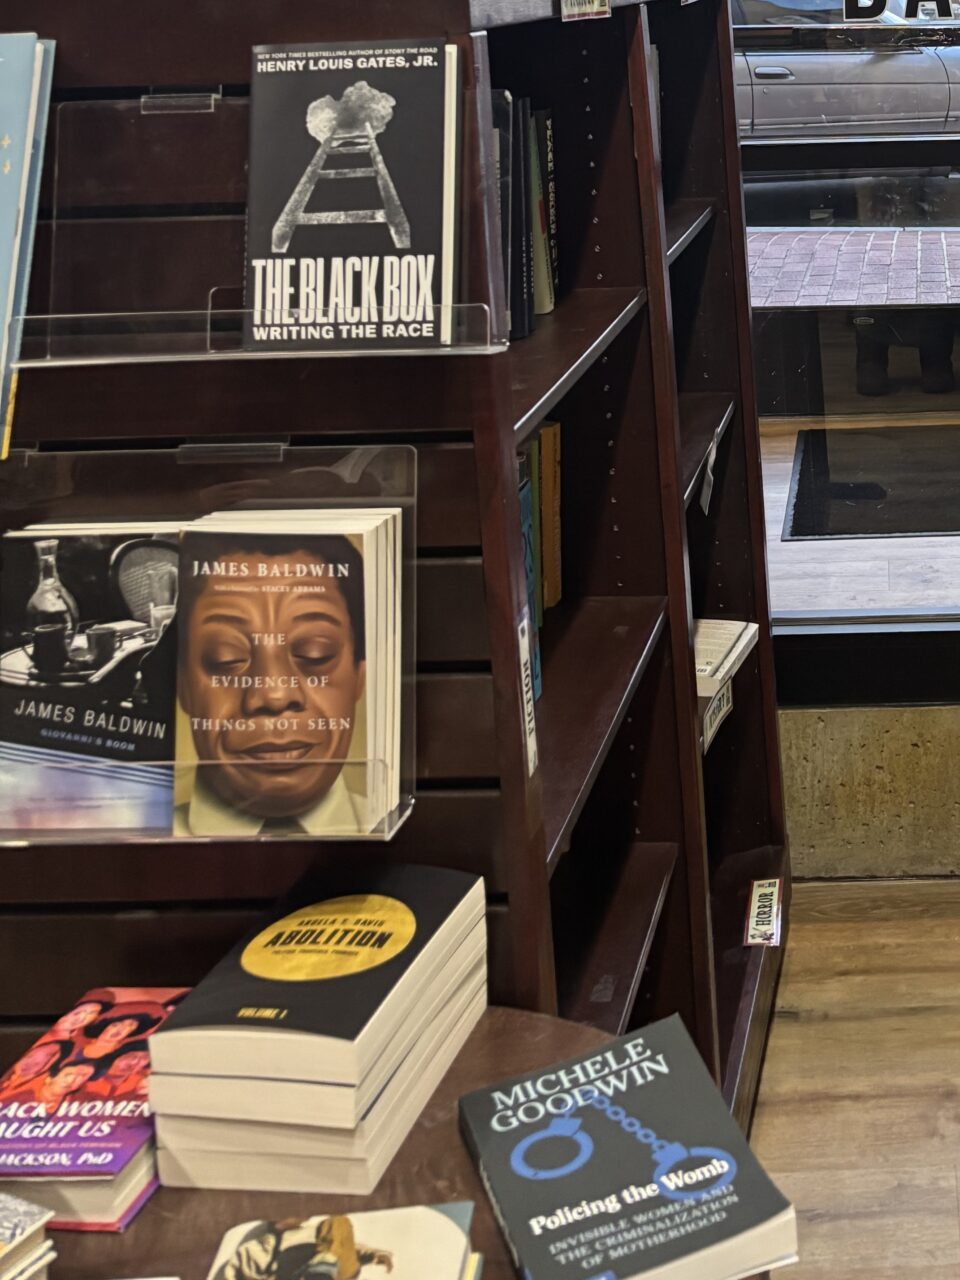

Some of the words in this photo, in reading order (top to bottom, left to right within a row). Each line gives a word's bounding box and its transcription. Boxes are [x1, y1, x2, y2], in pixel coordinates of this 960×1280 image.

[257, 60, 305, 72] HENRY
[309, 58, 353, 70] LOUIS
[356, 56, 410, 69] GATES,
[413, 55, 438, 67] JR.
[251, 258, 296, 325] THE
[299, 256, 379, 324] BLACK
[382, 254, 435, 322] BOX
[253, 325, 334, 340] WRITING
[339, 324, 377, 339] THE
[382, 323, 434, 338] RACE
[193, 561, 249, 576] JAMES
[257, 563, 350, 577] BALDWIN
[251, 633, 286, 646] THE
[211, 675, 300, 688] EVIDENCE
[307, 675, 329, 687] OF
[13, 699, 75, 724] JAMES
[83, 709, 166, 740] BALDWIN
[192, 718, 256, 732] THINGS
[264, 719, 301, 731] NOT
[308, 718, 351, 730] SEEN
[40, 728, 102, 746] GIOVANNI'S
[105, 739, 136, 751] ROOM
[755, 889, 775, 930] HORROR
[263, 928, 393, 950] ABOLITION
[491, 1037, 652, 1112] MICHELE
[490, 1054, 669, 1132] GOODWIN
[0, 1101, 47, 1118] ACK
[56, 1100, 150, 1118] WOMEN
[77, 1120, 116, 1137] US
[528, 1194, 622, 1236] Policing
[622, 1182, 660, 1203] the
[660, 1159, 730, 1192] Womb
[549, 1219, 630, 1254] INVISIBLE
[633, 1198, 695, 1224] WOMEN
[698, 1184, 734, 1204] AND
[554, 1245, 591, 1265] THE
[594, 1194, 739, 1254] CRIMINALIZATION
[581, 1254, 605, 1269] OF
[609, 1211, 727, 1263] MOTHERHOOD
